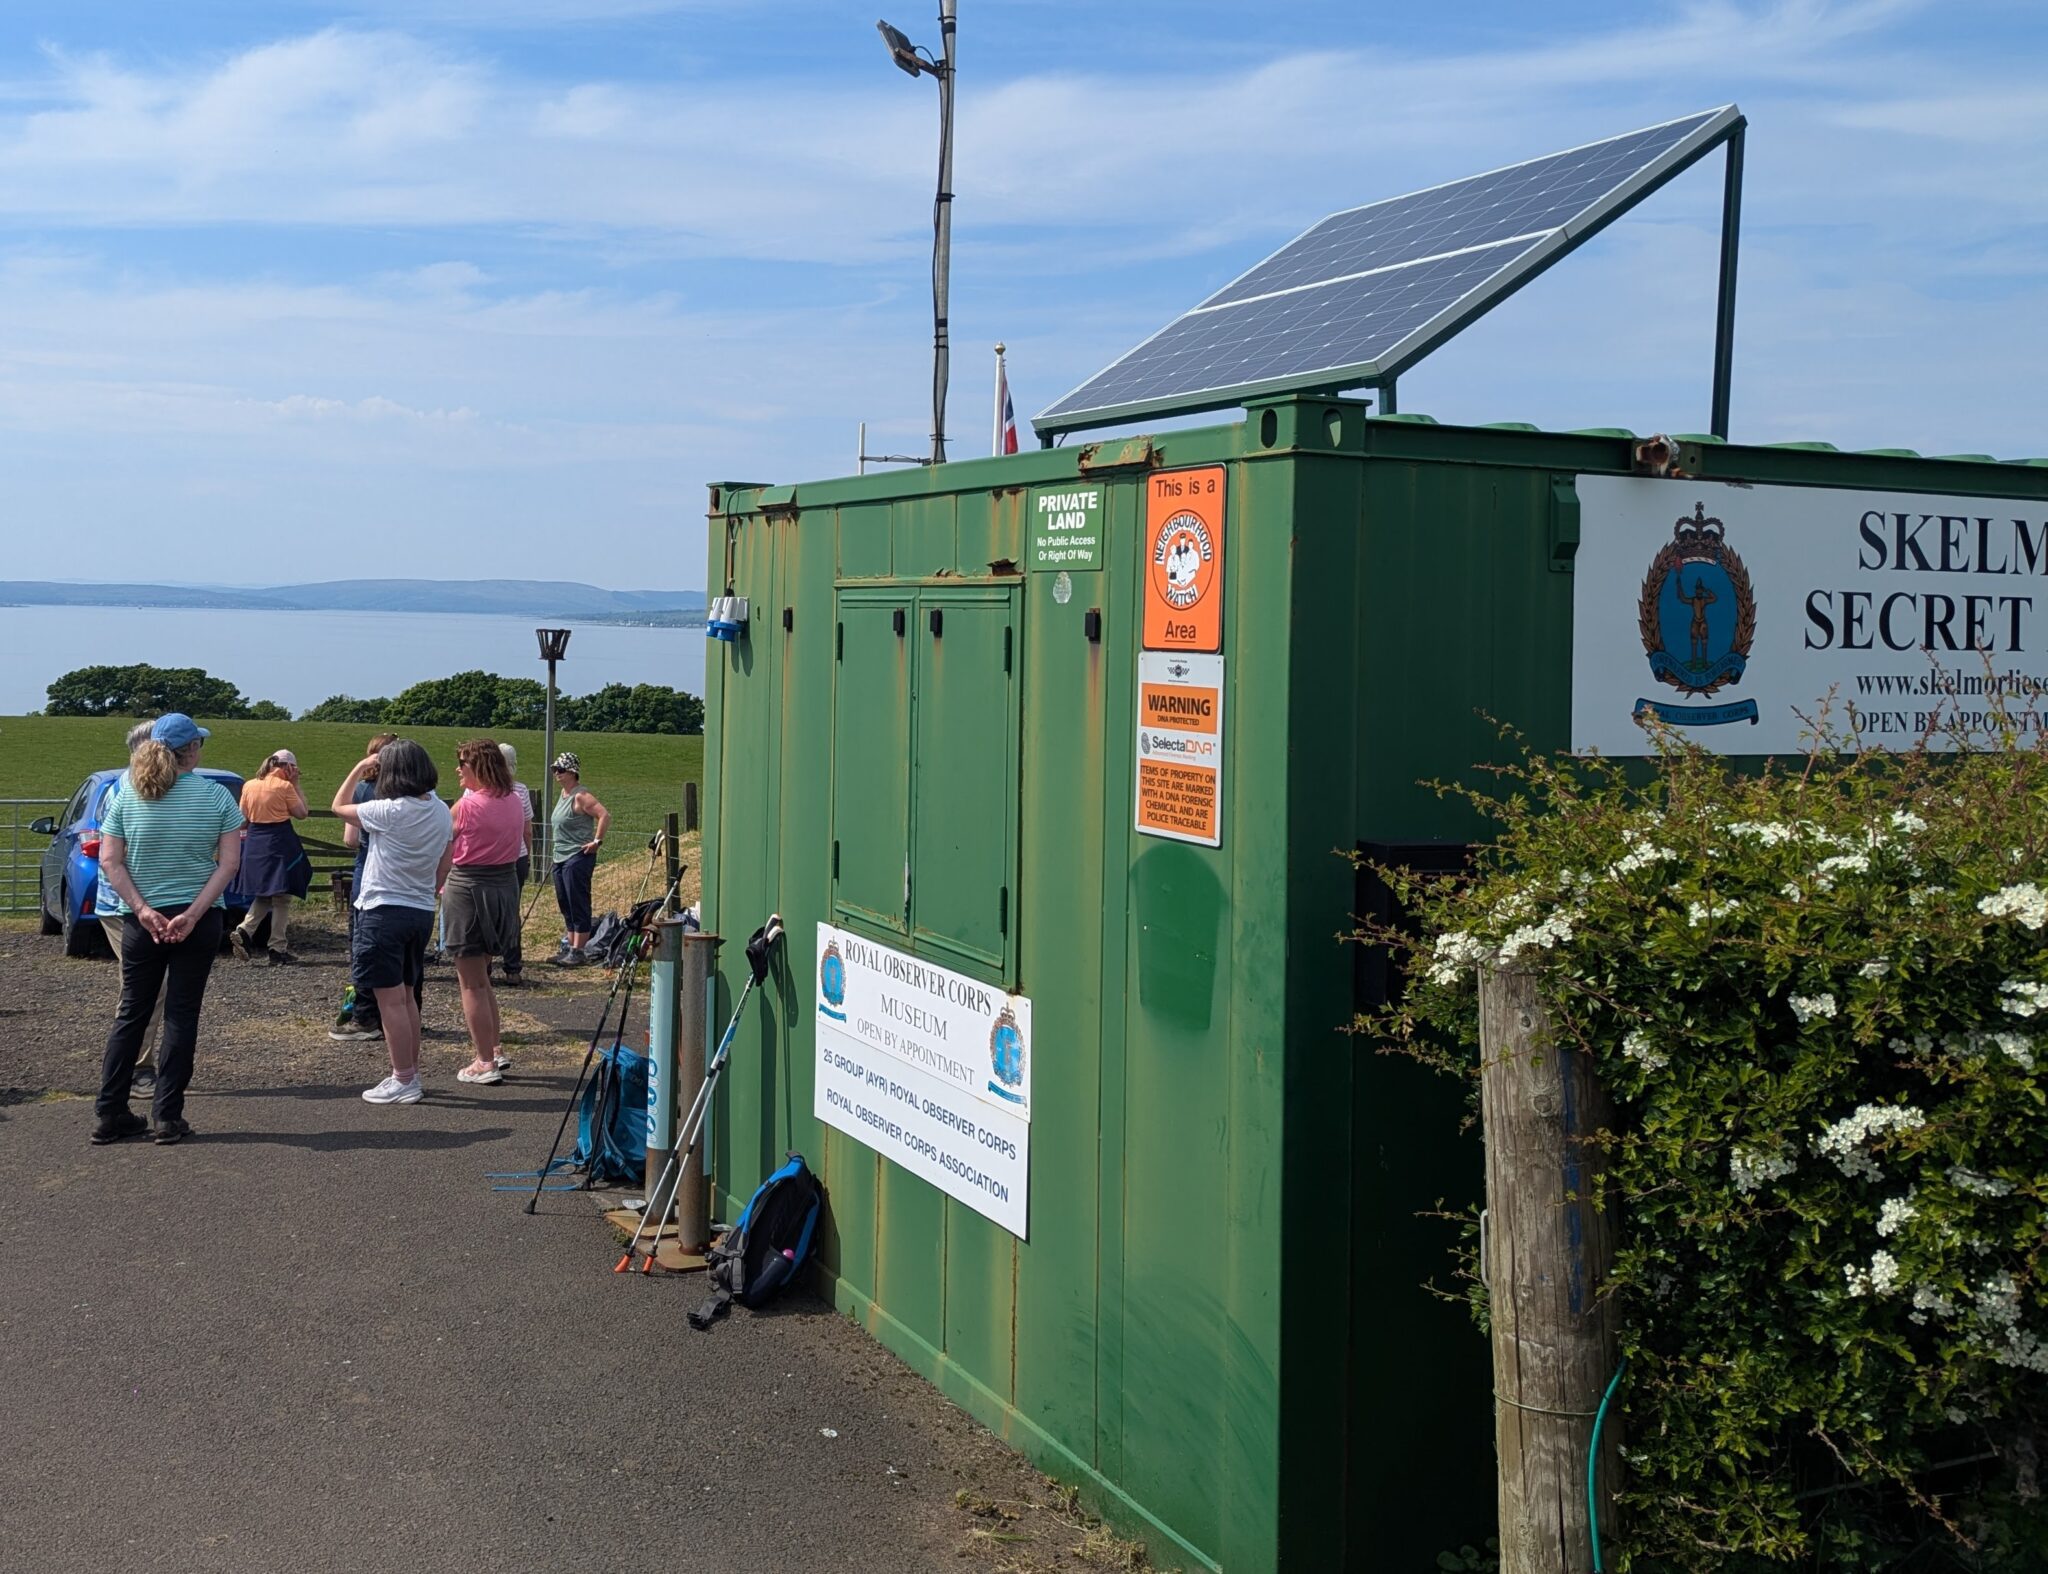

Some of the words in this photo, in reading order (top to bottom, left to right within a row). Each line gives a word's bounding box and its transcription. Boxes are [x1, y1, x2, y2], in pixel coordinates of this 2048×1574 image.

[1156, 480, 1182, 497] This
[1189, 477, 1200, 494] is
[1207, 479, 1215, 493] a
[1039, 492, 1097, 512] PRIVATE
[1048, 512, 1085, 530] LAND
[1037, 537, 1046, 546] No
[1048, 536, 1068, 546] Public
[1070, 536, 1095, 545] Access
[1155, 514, 1212, 563] NEIGHBOURHOOD
[1858, 510, 2048, 576] SKELM
[1039, 551, 1047, 560] Or
[1048, 551, 1066, 562] Right
[1067, 550, 1076, 560] Of
[1077, 550, 1092, 562] Way
[1166, 587, 1197, 606] WATCH
[1165, 621, 1196, 638] Area
[1805, 590, 2032, 652] SECRET
[1148, 694, 1210, 716] WARNING
[1170, 716, 1200, 726] PROTECTED
[1852, 712, 1908, 733] OPEN
[1141, 765, 1158, 775] ITEMS
[1160, 768, 1168, 776] OF
[1171, 770, 1203, 781] PROPERTY
[1205, 775, 1215, 784] ON
[1142, 777, 1155, 786] THIS
[1157, 779, 1169, 789] SITE
[1172, 781, 1183, 791] ARE
[1186, 784, 1213, 795] MARKED
[1142, 788, 1157, 798] WITH
[1159, 791, 1164, 799] A
[1166, 792, 1179, 802] DNA
[1182, 795, 1213, 808] FORENSIC
[1146, 800, 1177, 813] CHEMICAL
[1180, 806, 1193, 816] AND
[1195, 809, 1208, 819] ARE
[1147, 812, 1168, 823] POLICE
[1170, 816, 1206, 830] TRACEABLE
[846, 940, 881, 973] ROYAL
[884, 955, 945, 999] OBSERVER
[949, 979, 991, 1016] CORPS
[881, 994, 947, 1040] MUSEUM
[857, 1018, 882, 1042] OPEN
[885, 1029, 898, 1047] BY
[900, 1036, 974, 1085] APPOINTMENT
[824, 1049, 833, 1064] 25
[835, 1054, 864, 1079] GROUP
[866, 1070, 888, 1093] (AYR)
[890, 1082, 920, 1110] ROYAL
[923, 1099, 975, 1137] OBSERVER
[978, 1128, 1016, 1160] CORPS
[827, 1088, 853, 1114] ROYAL
[856, 1105, 901, 1141] OBSERVER
[904, 1132, 937, 1161] CORPS
[939, 1152, 1008, 1202] ASSOCIATION
